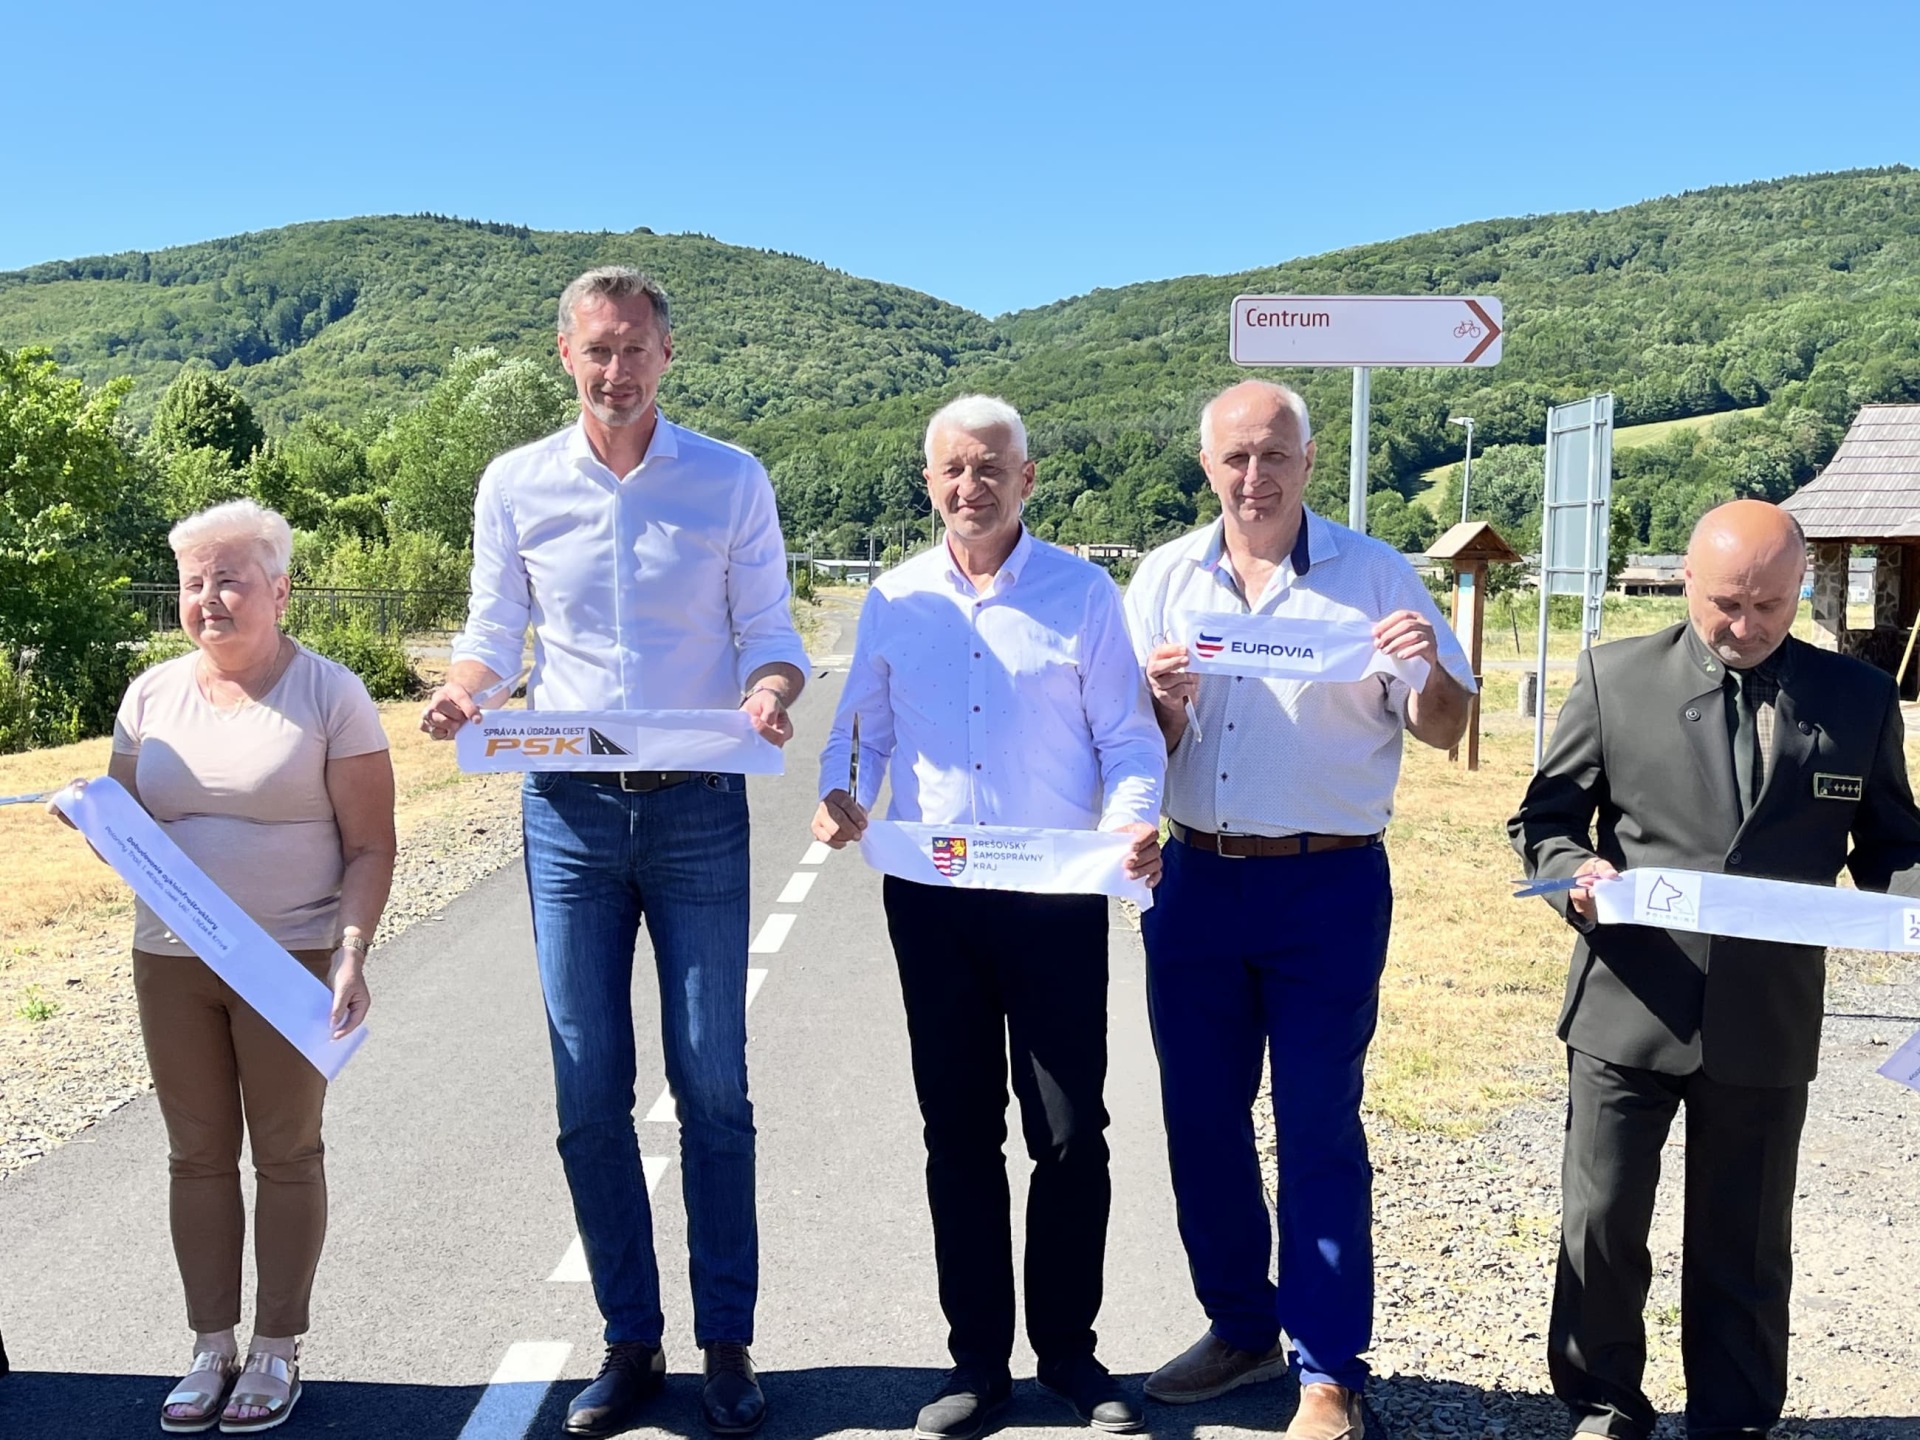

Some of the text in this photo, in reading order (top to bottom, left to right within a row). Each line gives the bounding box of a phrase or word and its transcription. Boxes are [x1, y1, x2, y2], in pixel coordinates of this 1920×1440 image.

[1246, 308, 1330, 327] Centrum
[1231, 641, 1315, 659] EUROVIA
[483, 726, 586, 737] SPRÁVA A ÚDRŽBA CIEST
[484, 737, 586, 757] PSK
[972, 839, 1027, 850] PREŠOVSKÝ
[973, 851, 1044, 862] SAMOSPRÁVNY
[973, 862, 998, 871] KRAJ
